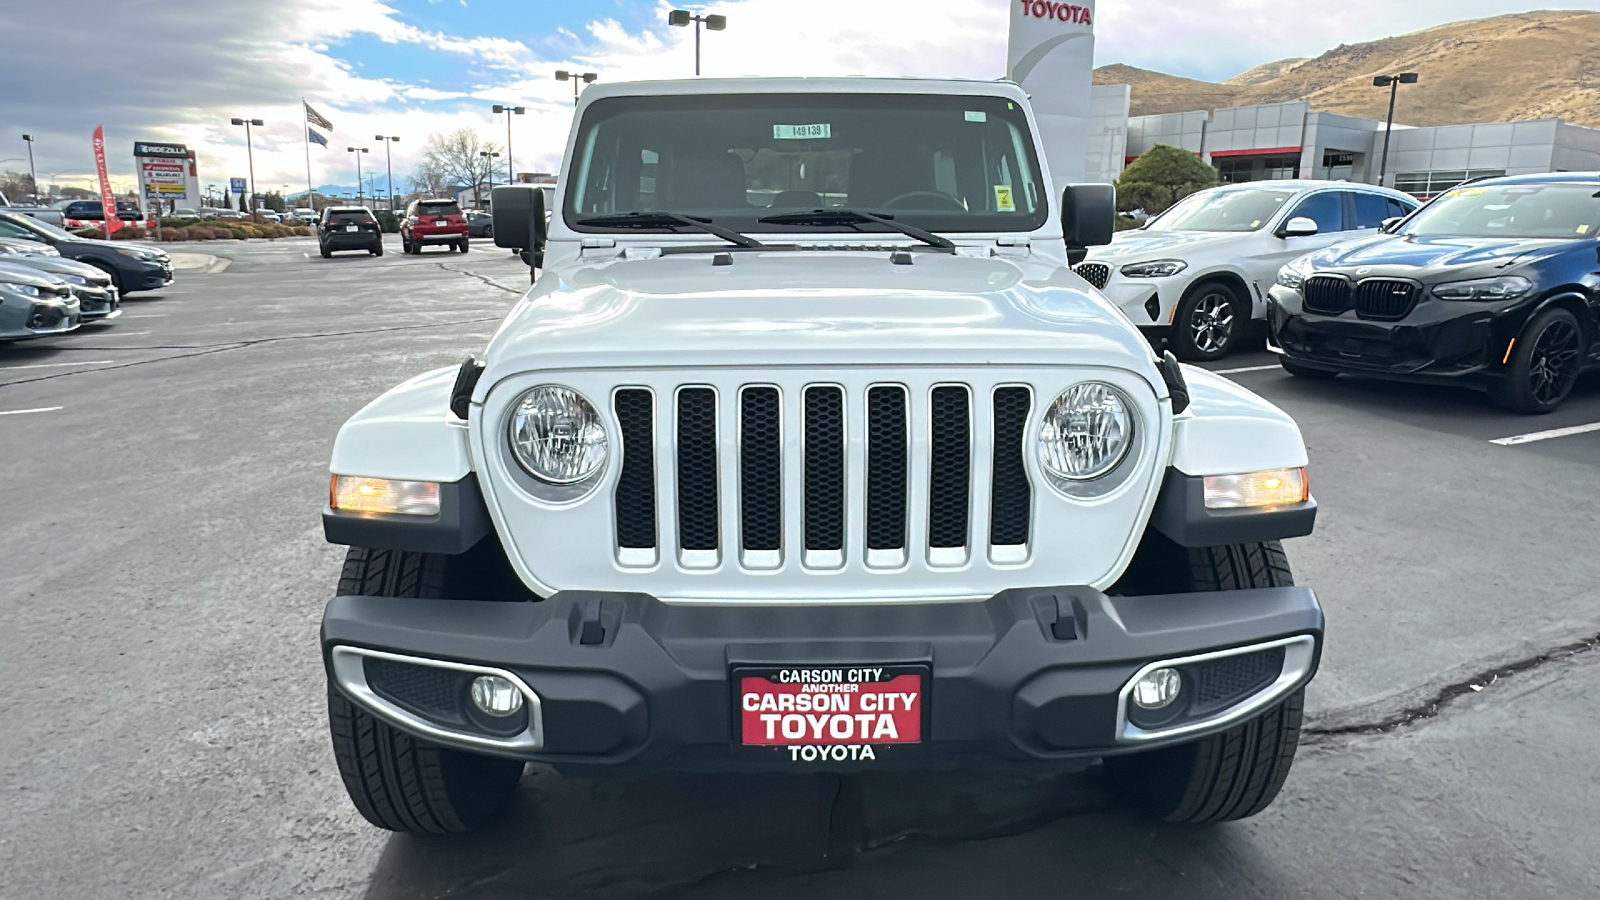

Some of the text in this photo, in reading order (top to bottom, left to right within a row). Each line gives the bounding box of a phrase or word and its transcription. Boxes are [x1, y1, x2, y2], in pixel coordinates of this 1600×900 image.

[1021, 0, 1092, 25] TOYOTA
[793, 125, 821, 136] 149139
[148, 146, 186, 154] RIDEZILLA
[779, 668, 883, 683] CARSON CITY
[801, 683, 859, 693] ANOTHER
[742, 692, 918, 712] CARSON CITY
[760, 713, 899, 740] TOYOTA
[788, 744, 876, 761] TOYOTA
